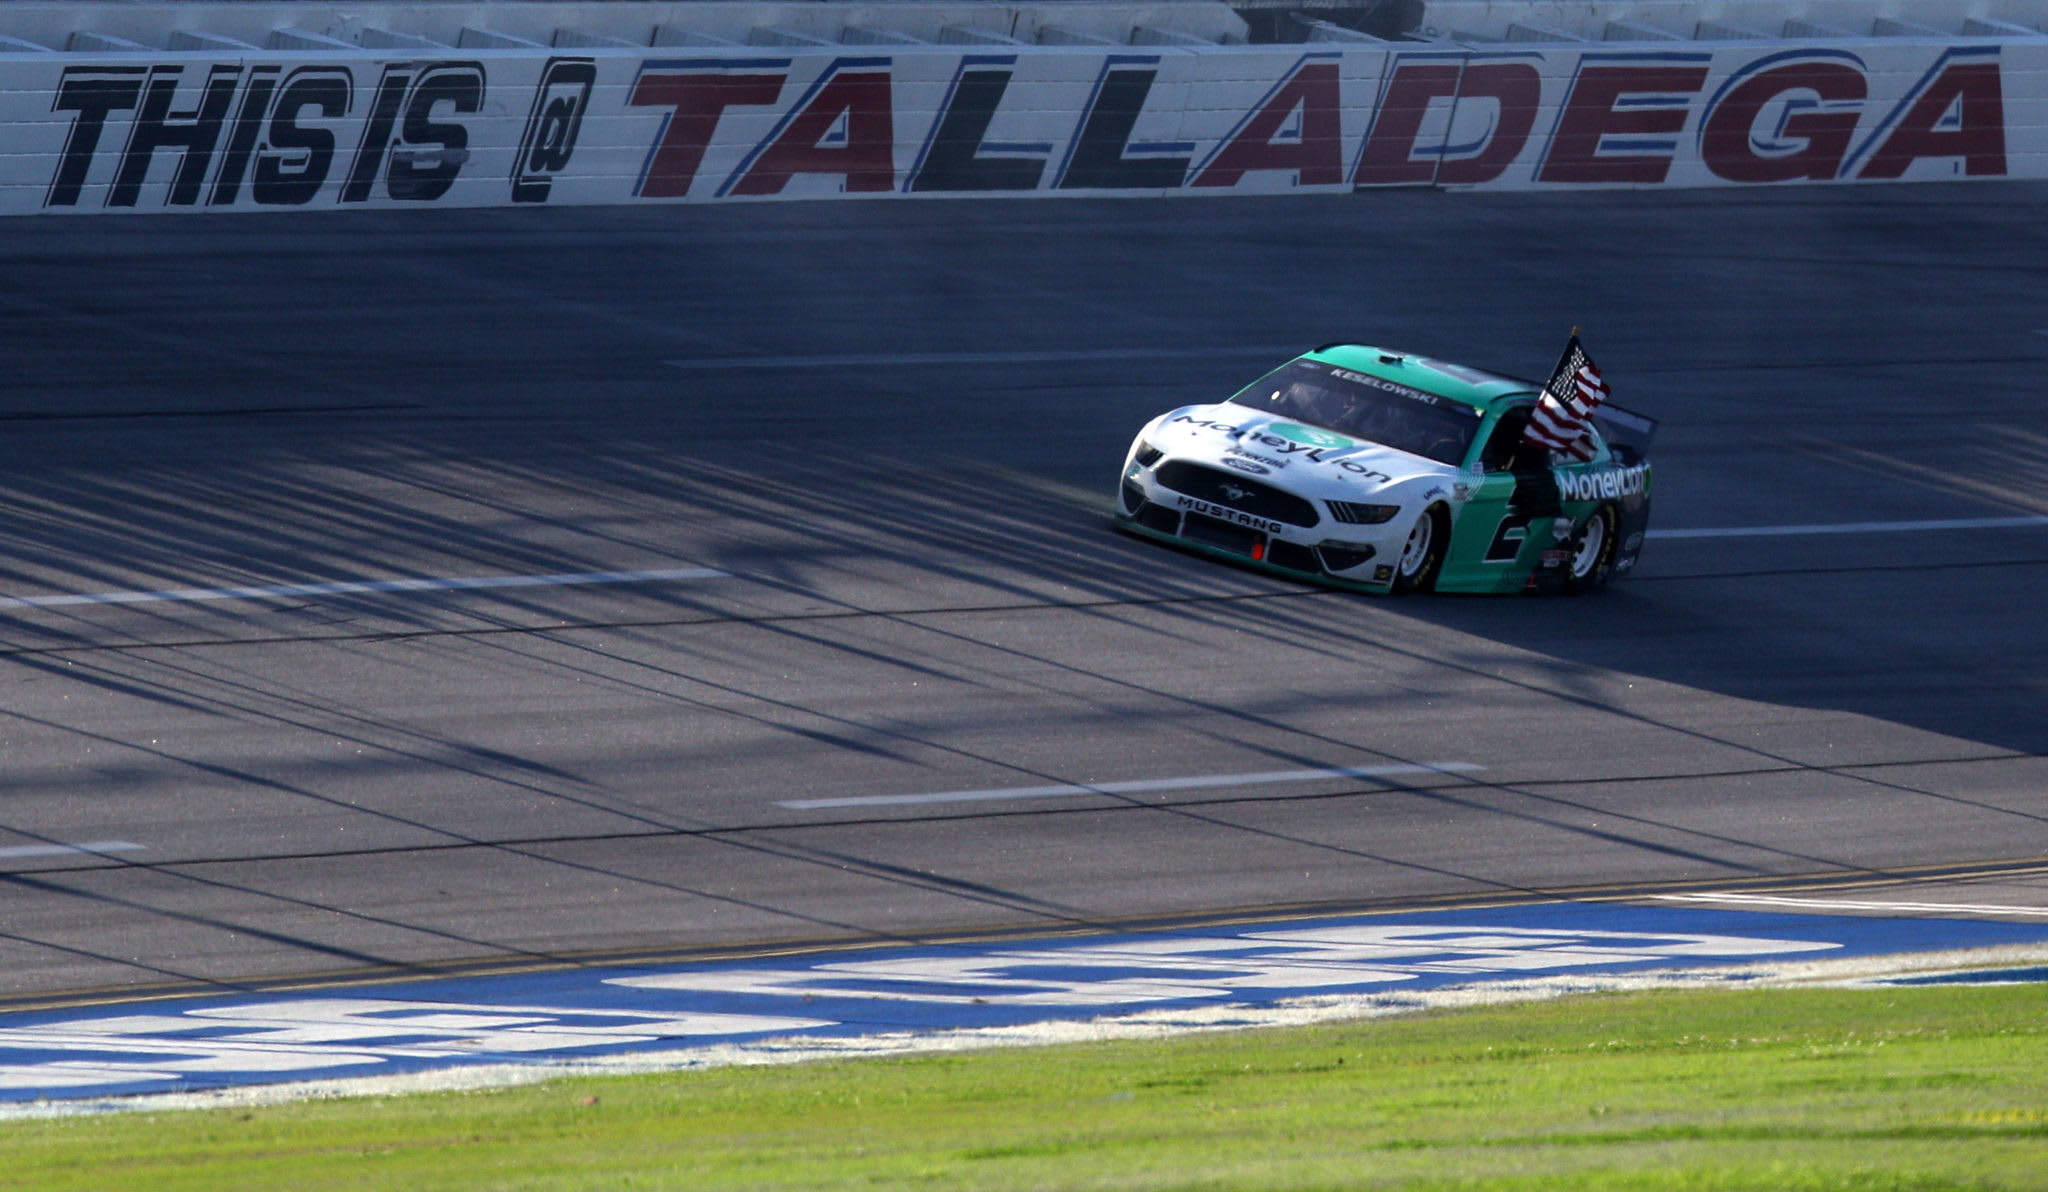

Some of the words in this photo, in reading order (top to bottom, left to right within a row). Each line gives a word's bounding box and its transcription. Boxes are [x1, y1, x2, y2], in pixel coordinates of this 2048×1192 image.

[43, 64, 353, 208] THIS
[337, 60, 486, 204] IS
[508, 57, 597, 203] @
[624, 45, 2008, 198] TALLADEGA
[1330, 367, 1438, 406] KESELOWSKI
[1173, 415, 1393, 484] MoneyLion
[1558, 466, 1645, 501] MoneyLion
[1176, 495, 1283, 534] MUSTANG
